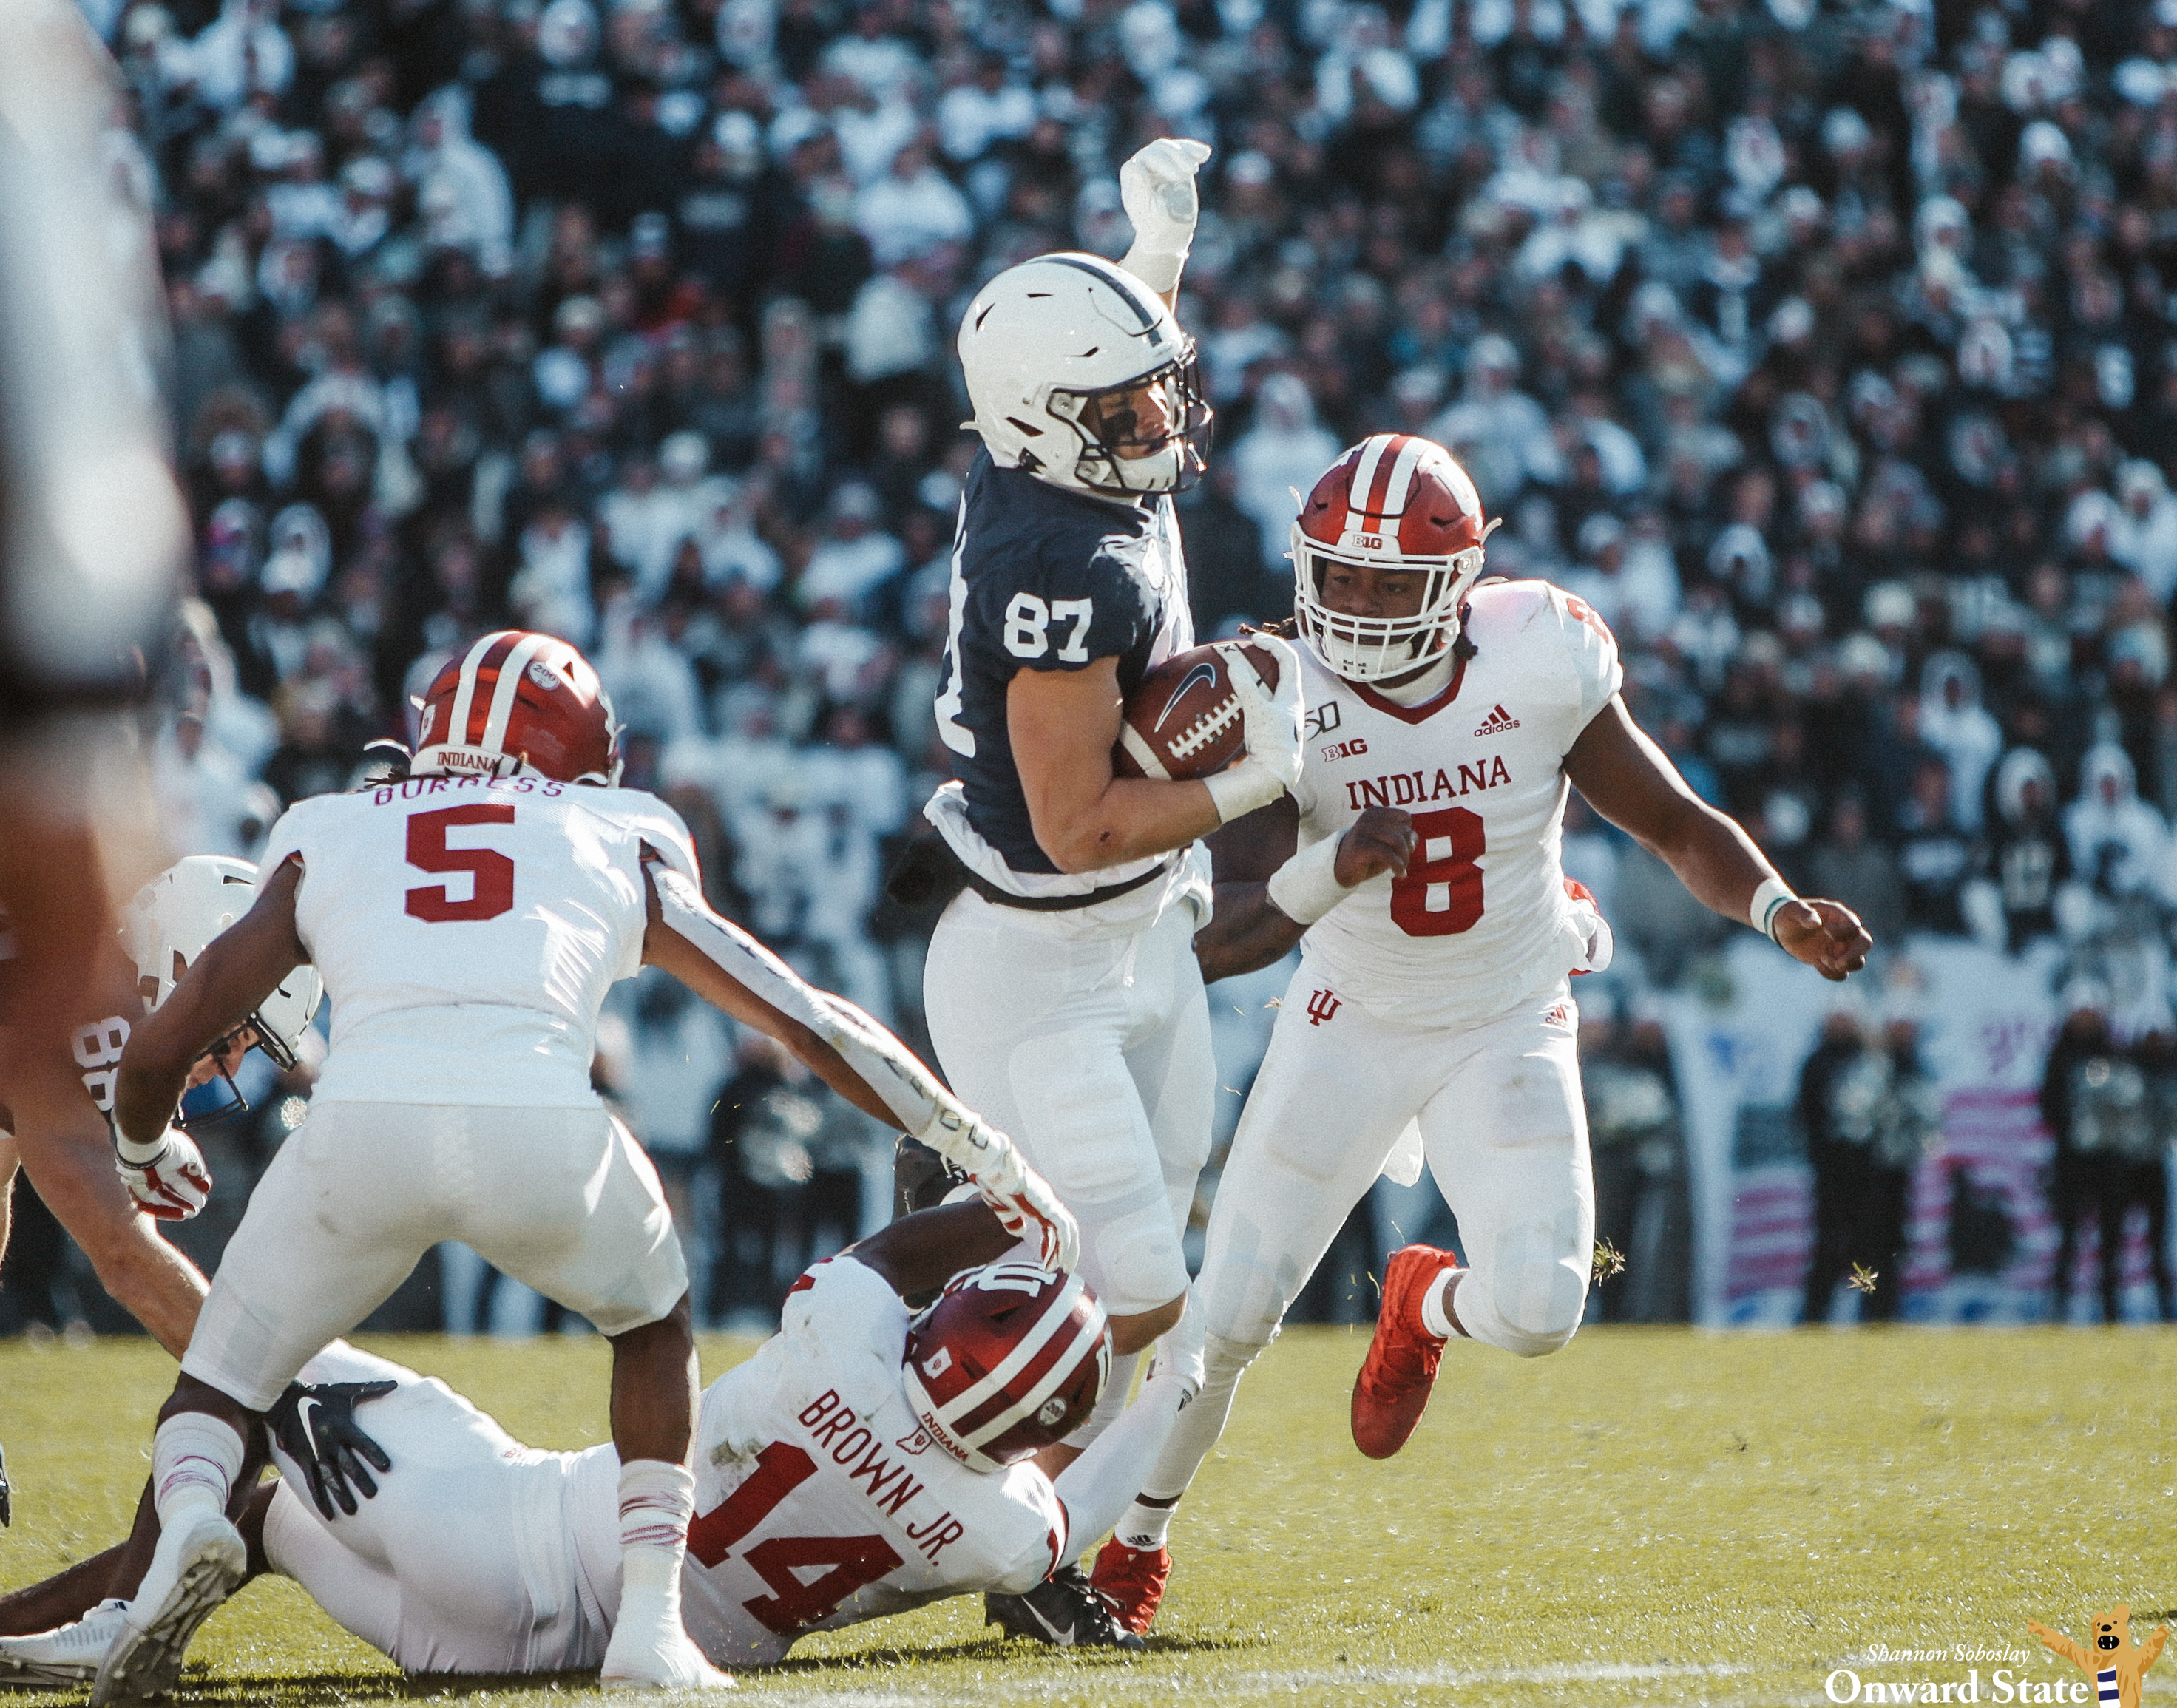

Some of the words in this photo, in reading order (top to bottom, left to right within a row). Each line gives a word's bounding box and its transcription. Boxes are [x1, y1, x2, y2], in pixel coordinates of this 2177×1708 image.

[1003, 592, 1093, 662] 87
[437, 752, 501, 772] INDIANA
[1474, 718, 1521, 737] adidas
[1345, 755, 1512, 811] INDIANA
[404, 803, 515, 925] 5
[1390, 805, 1486, 938] 8
[921, 1412, 970, 1462] INDIANA
[798, 1389, 924, 1518] BROWN
[906, 1511, 964, 1567] JR.
[687, 1440, 905, 1636] 14
